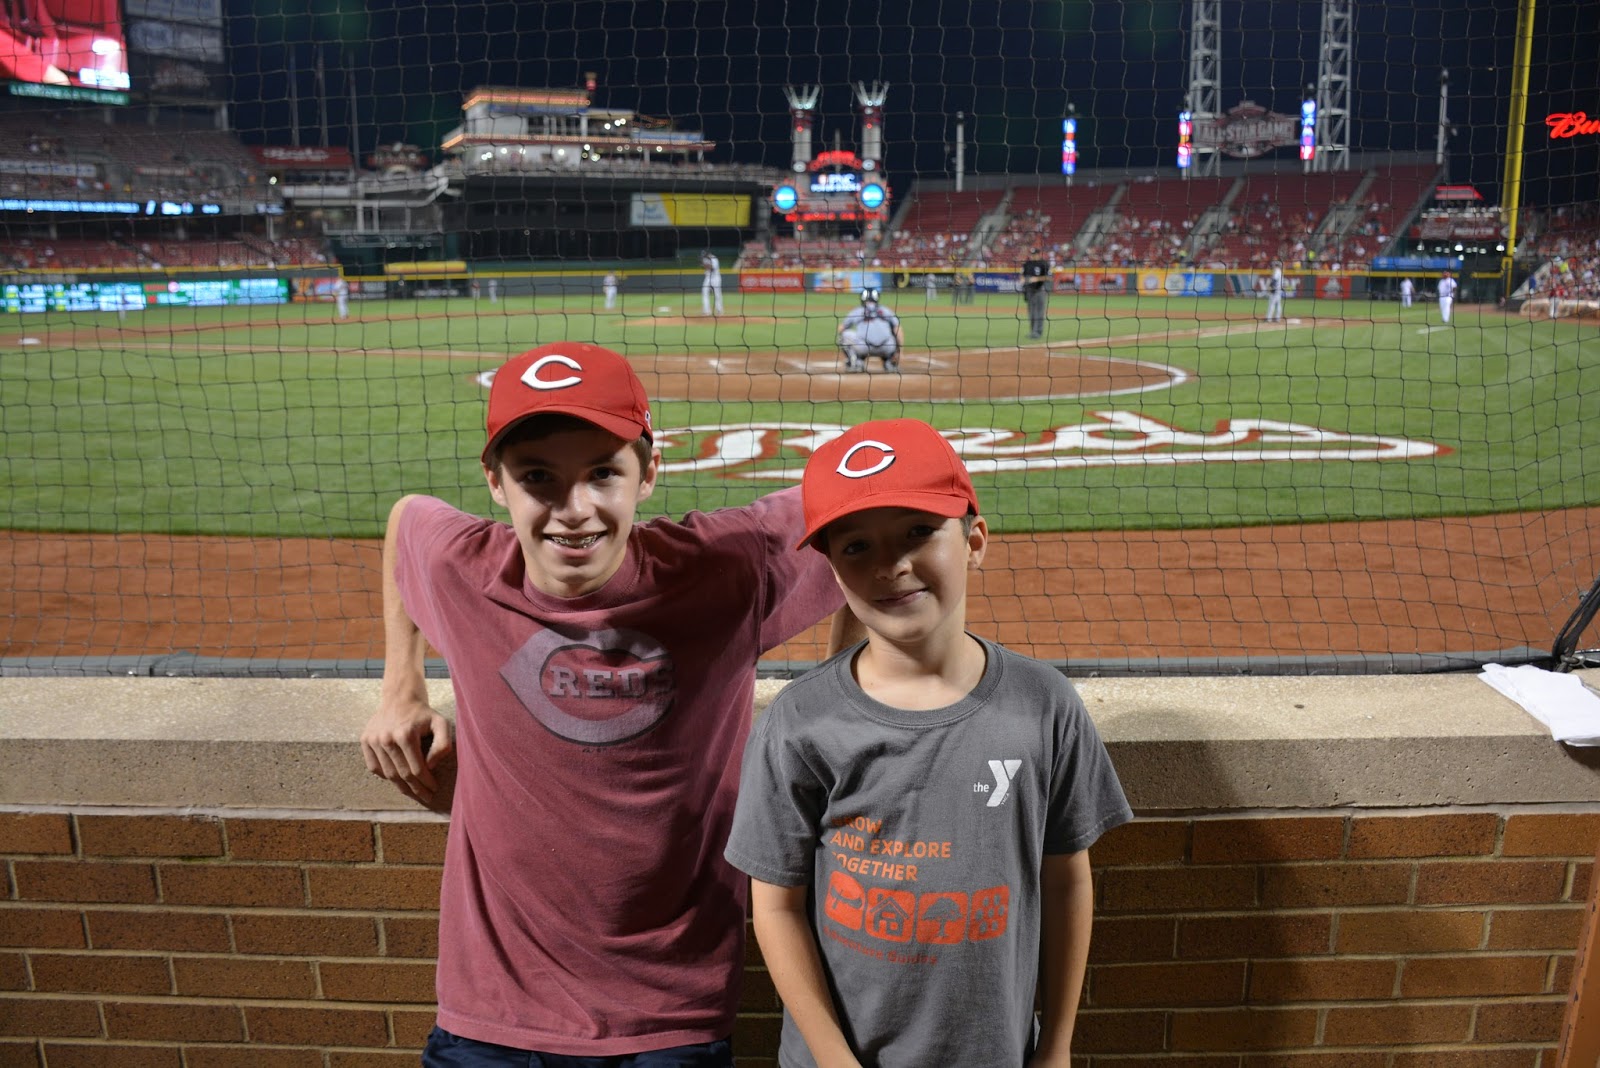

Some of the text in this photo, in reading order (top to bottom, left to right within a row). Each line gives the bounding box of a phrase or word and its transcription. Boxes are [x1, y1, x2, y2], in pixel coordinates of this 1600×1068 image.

[520, 354, 583, 391] C
[836, 440, 896, 479] C
[973, 781, 990, 792] the
[829, 830, 952, 859] AND EXPLORE
